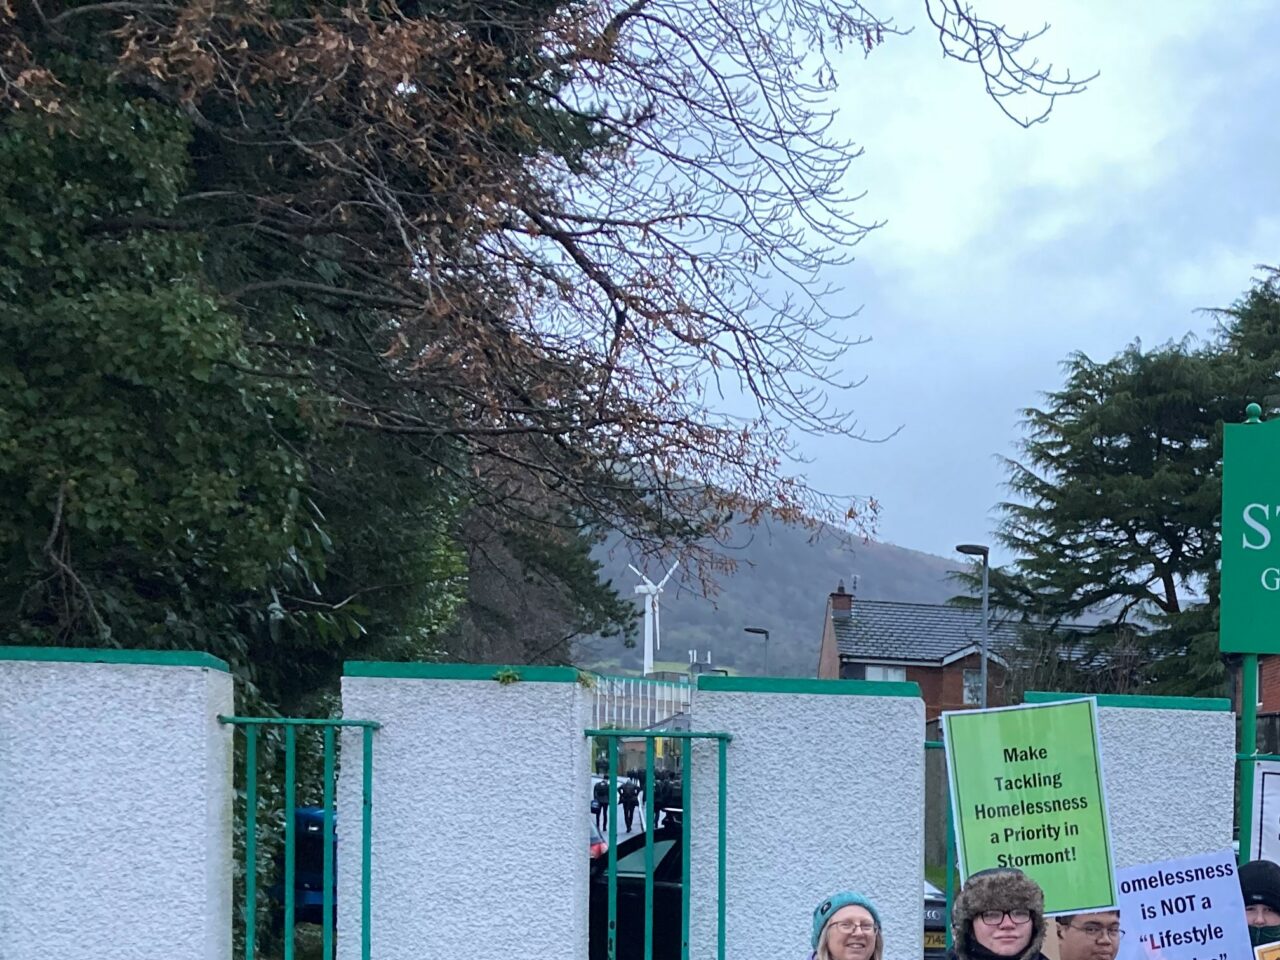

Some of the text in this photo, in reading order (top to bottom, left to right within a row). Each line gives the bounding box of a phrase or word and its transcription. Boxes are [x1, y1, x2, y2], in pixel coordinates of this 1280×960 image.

[1003, 746, 1048, 763] Make
[994, 772, 1063, 792] Tackling
[974, 796, 1088, 820] Homelessness
[990, 822, 1079, 844] a Priority in
[997, 847, 1076, 868] Stormont!
[1119, 863, 1234, 895] omelessness
[1140, 895, 1212, 920] is NOT a
[1139, 923, 1224, 950] “Lifestyle
